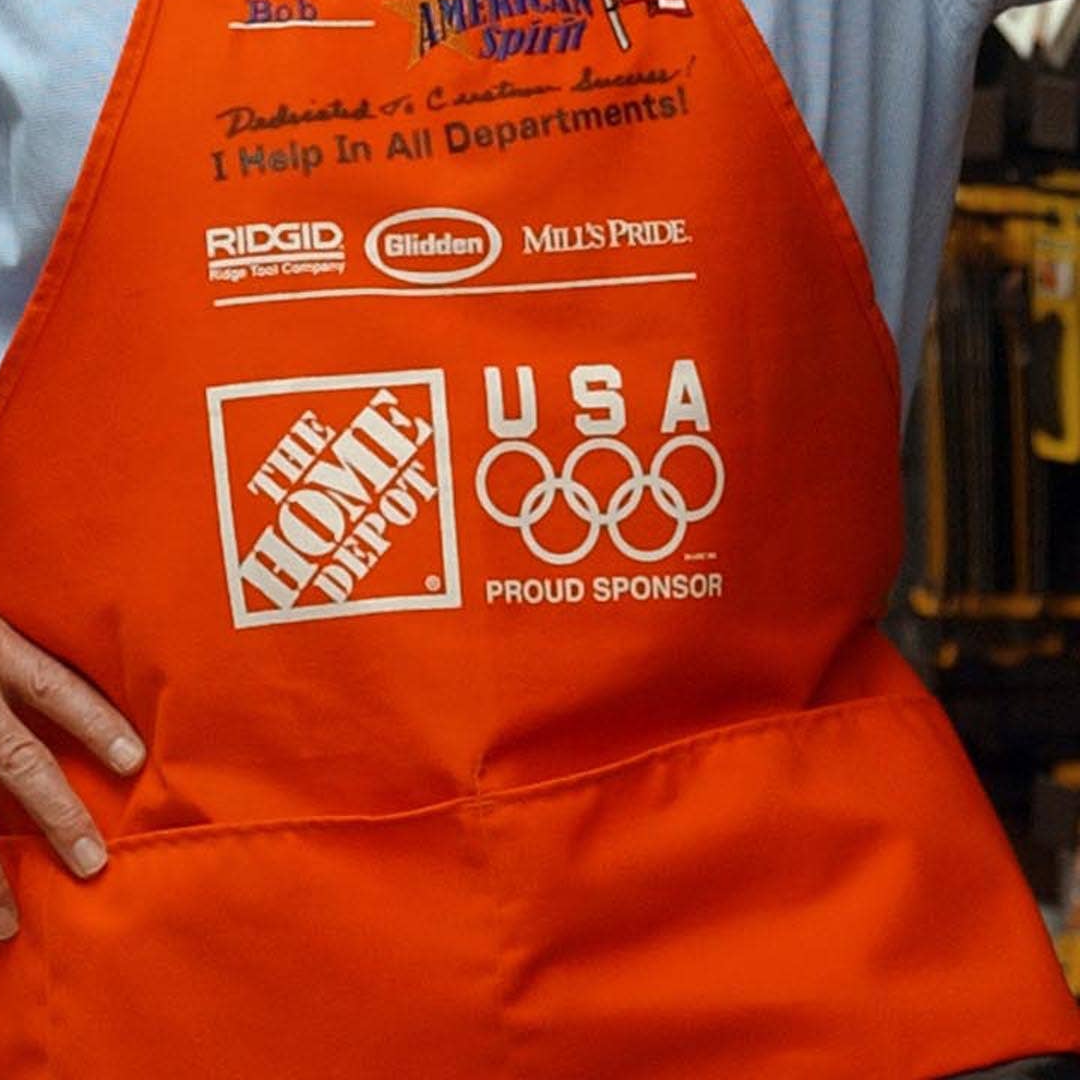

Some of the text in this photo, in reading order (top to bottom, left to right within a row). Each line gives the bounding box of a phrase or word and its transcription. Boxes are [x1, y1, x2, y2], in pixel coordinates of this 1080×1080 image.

[211, 84, 689, 182] I Help In All Departments!
[205, 221, 344, 258] RIDGID
[384, 233, 483, 258] Glidden
[238, 388, 433, 610] HOME
[248, 410, 336, 504] THE
[313, 460, 438, 604] DEPOT
[486, 573, 723, 605] PROUD SPONSOR
